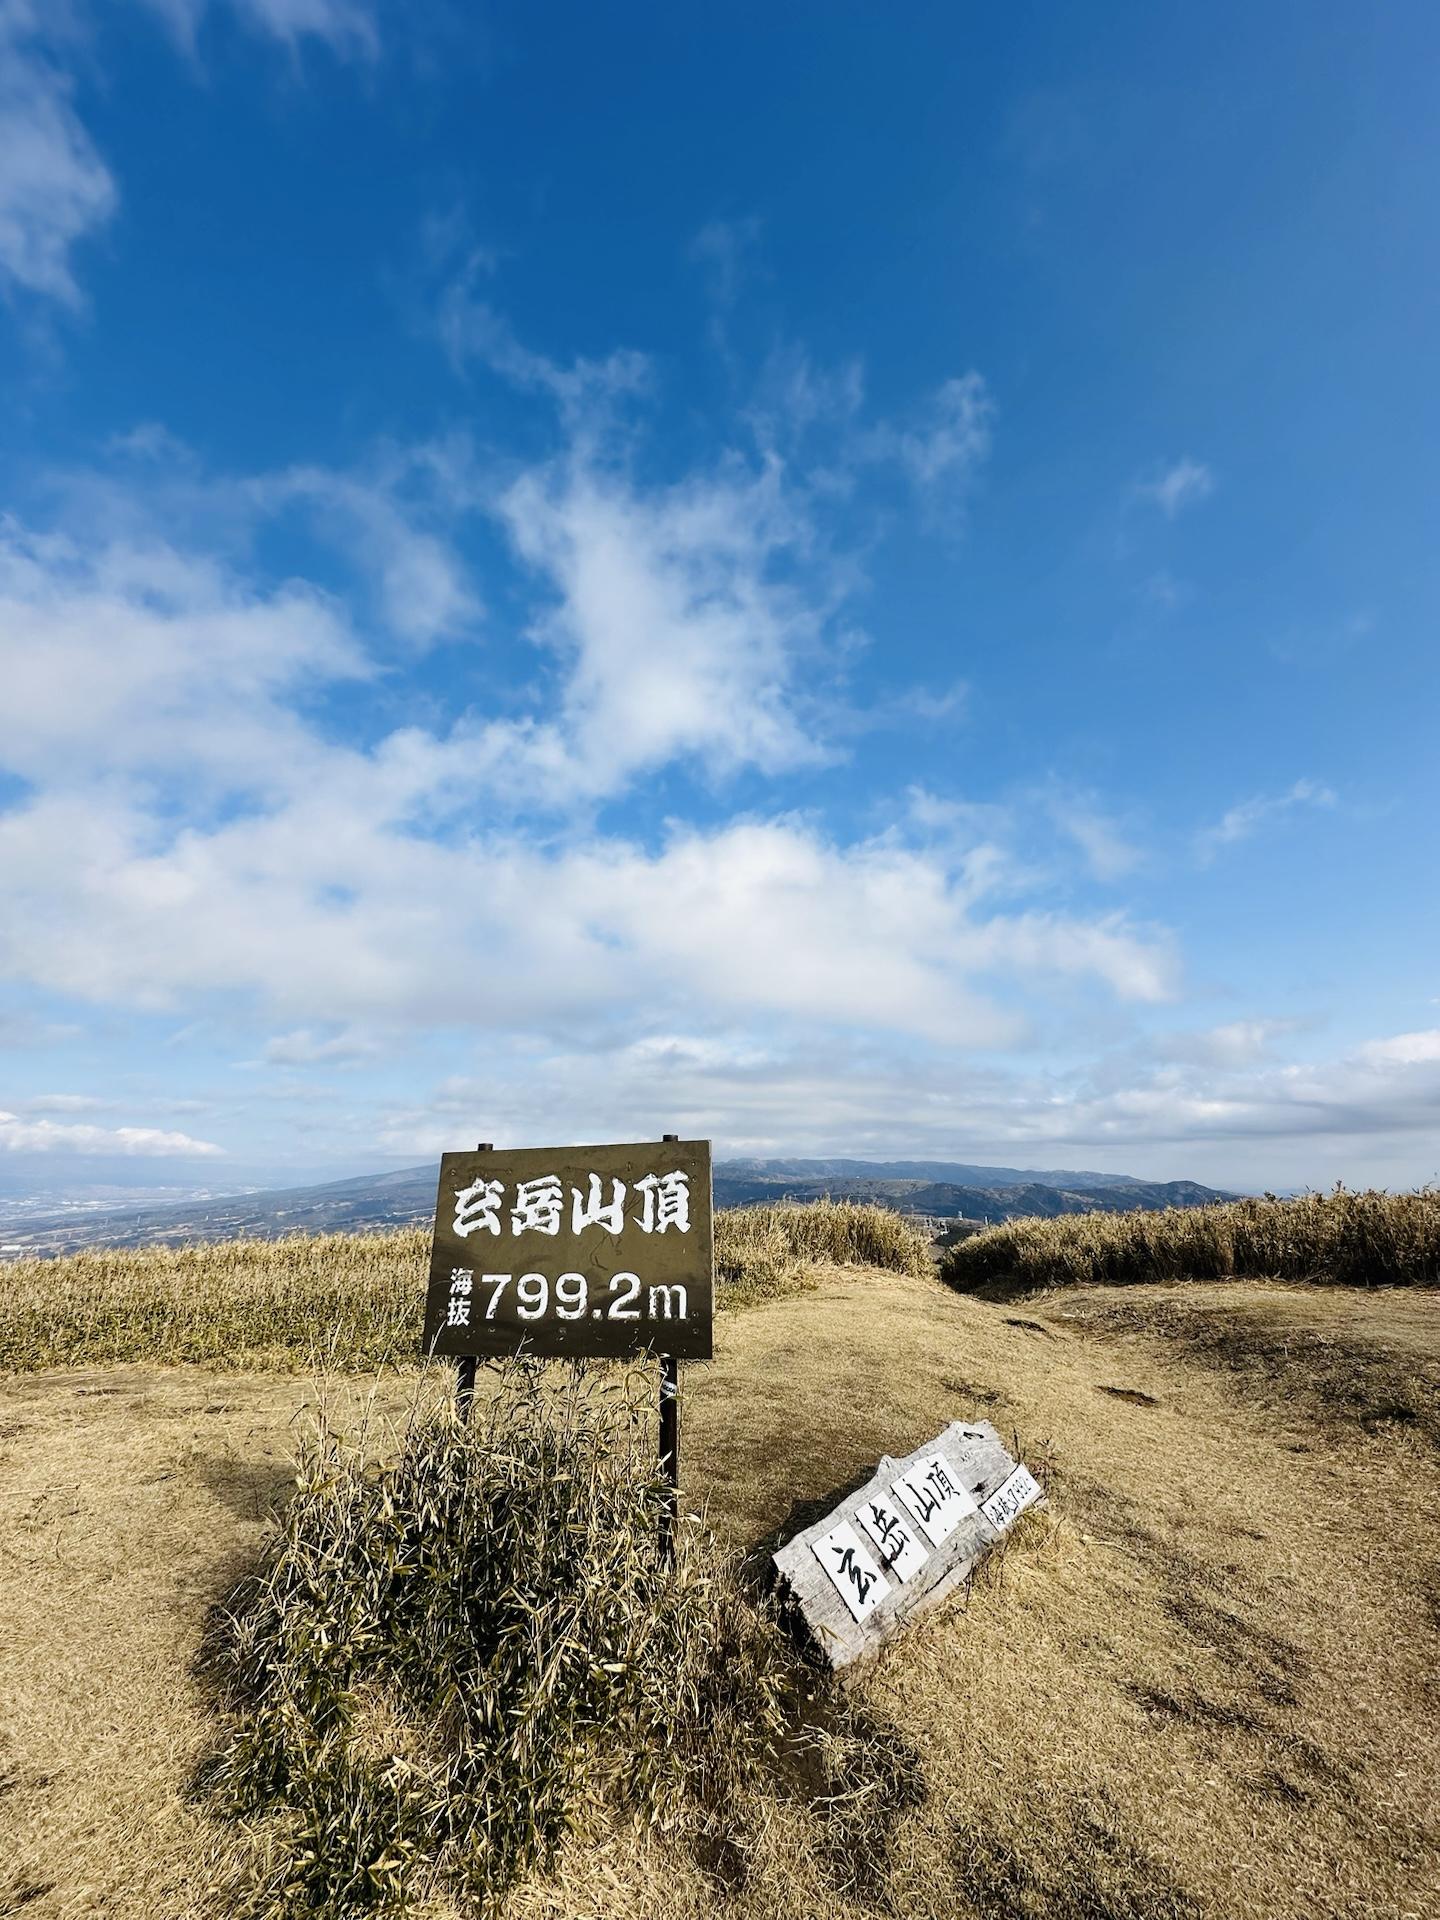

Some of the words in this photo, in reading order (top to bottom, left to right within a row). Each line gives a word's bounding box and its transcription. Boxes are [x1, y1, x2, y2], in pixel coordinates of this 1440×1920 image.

[452, 1170, 692, 1238] 玄岳山頂
[447, 1267, 474, 1327] 海抜
[481, 1271, 688, 1321] 799.2m
